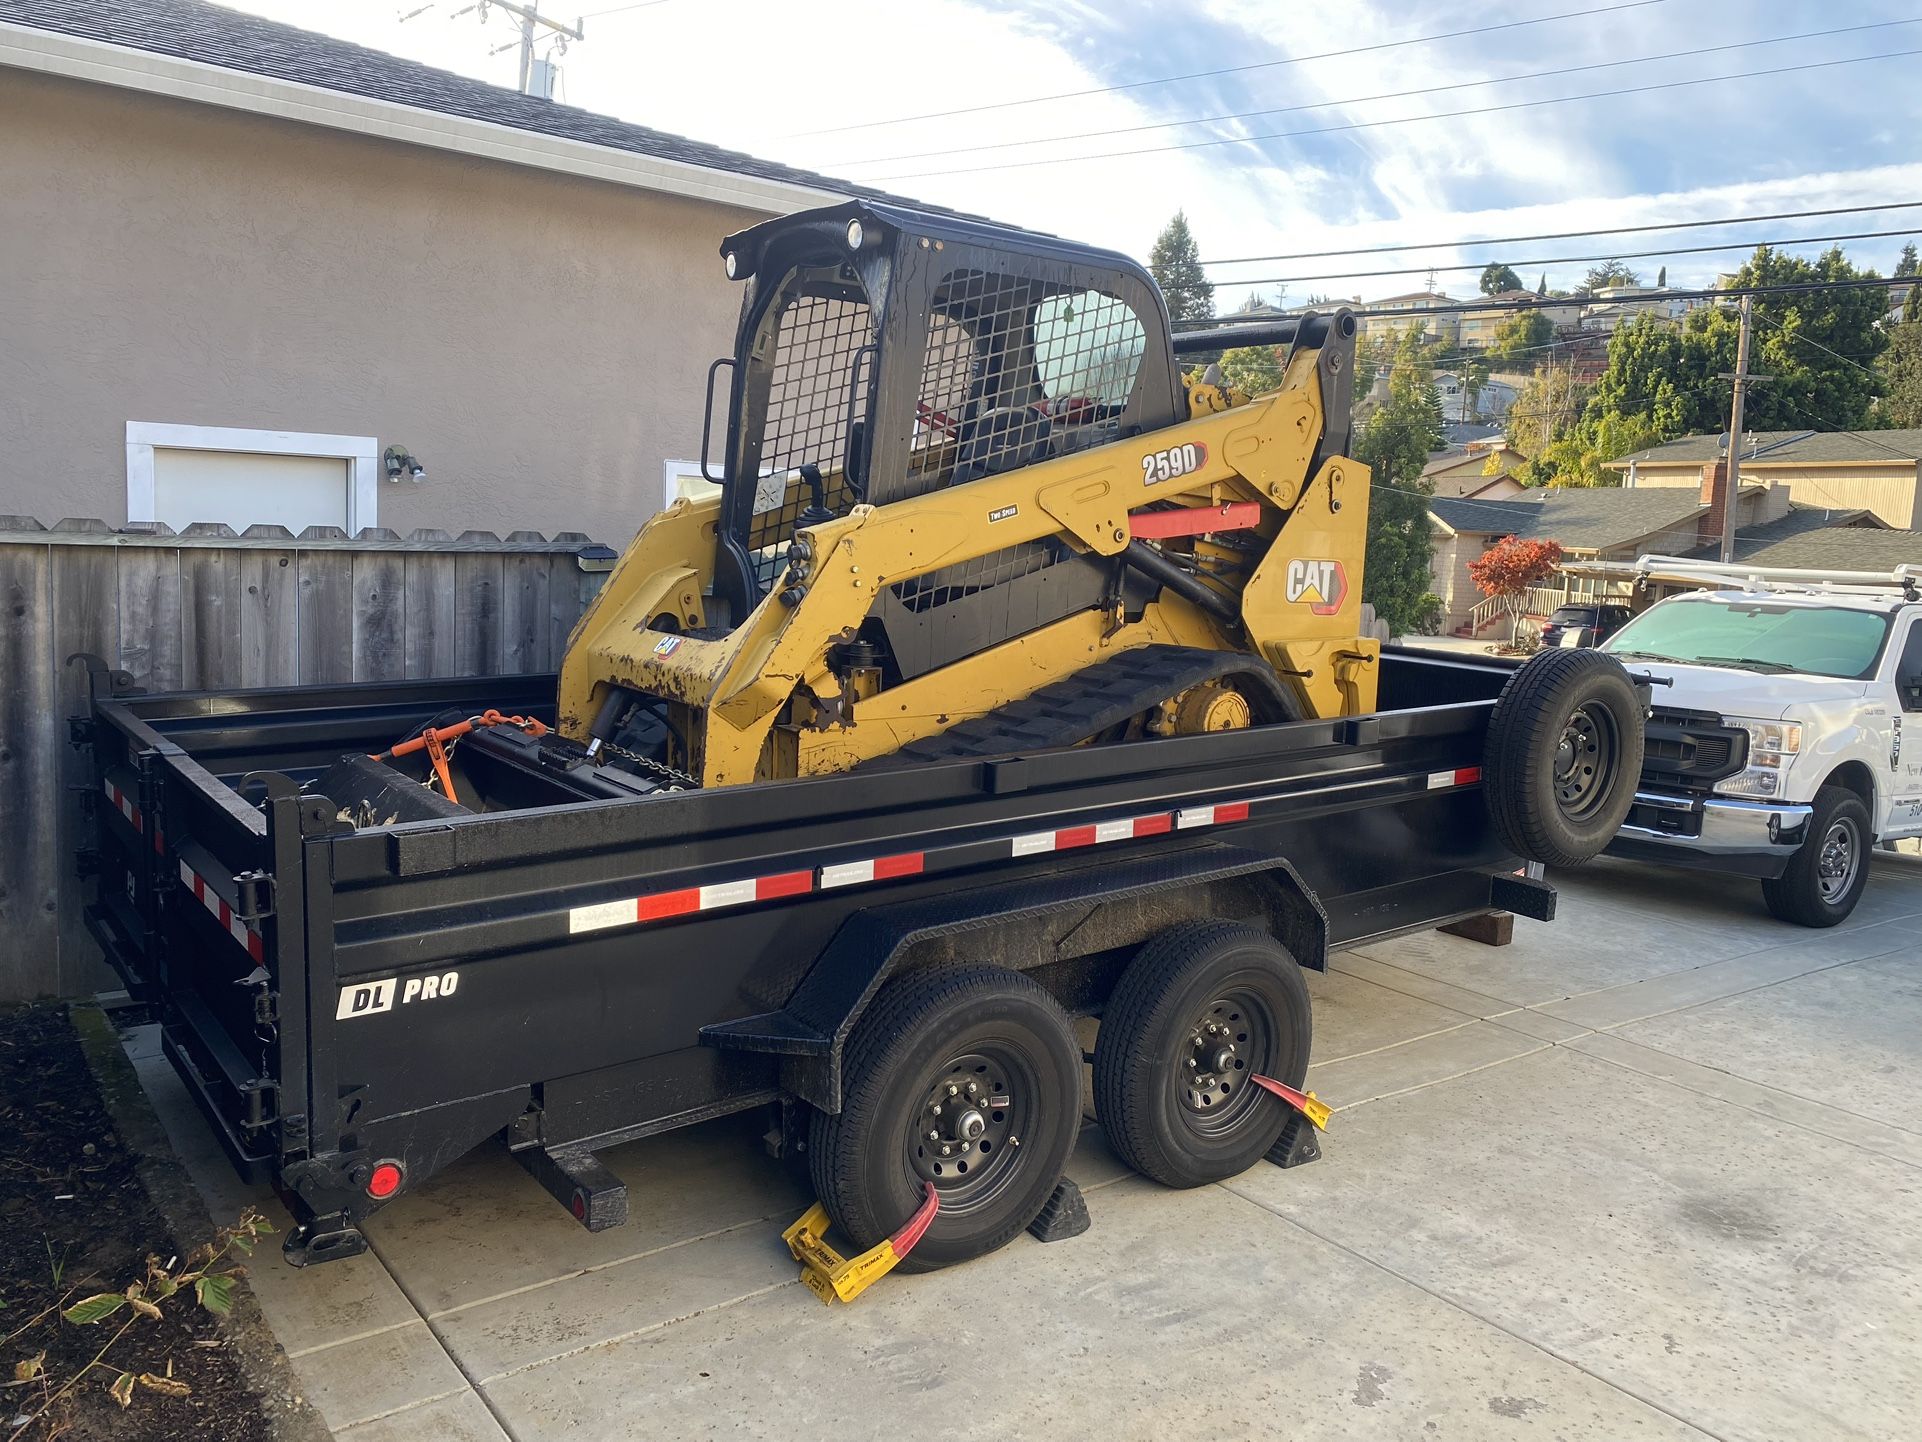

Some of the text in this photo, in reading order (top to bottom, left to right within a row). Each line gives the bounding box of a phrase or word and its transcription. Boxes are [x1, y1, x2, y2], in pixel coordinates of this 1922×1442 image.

[1142, 443, 1197, 486] 259D
[1287, 559, 1335, 603] CAT
[653, 636, 681, 655] CAT
[127, 869, 135, 898] PJ
[351, 971, 459, 1013] DL PRO
[859, 1253, 884, 1271] TRIMAX
